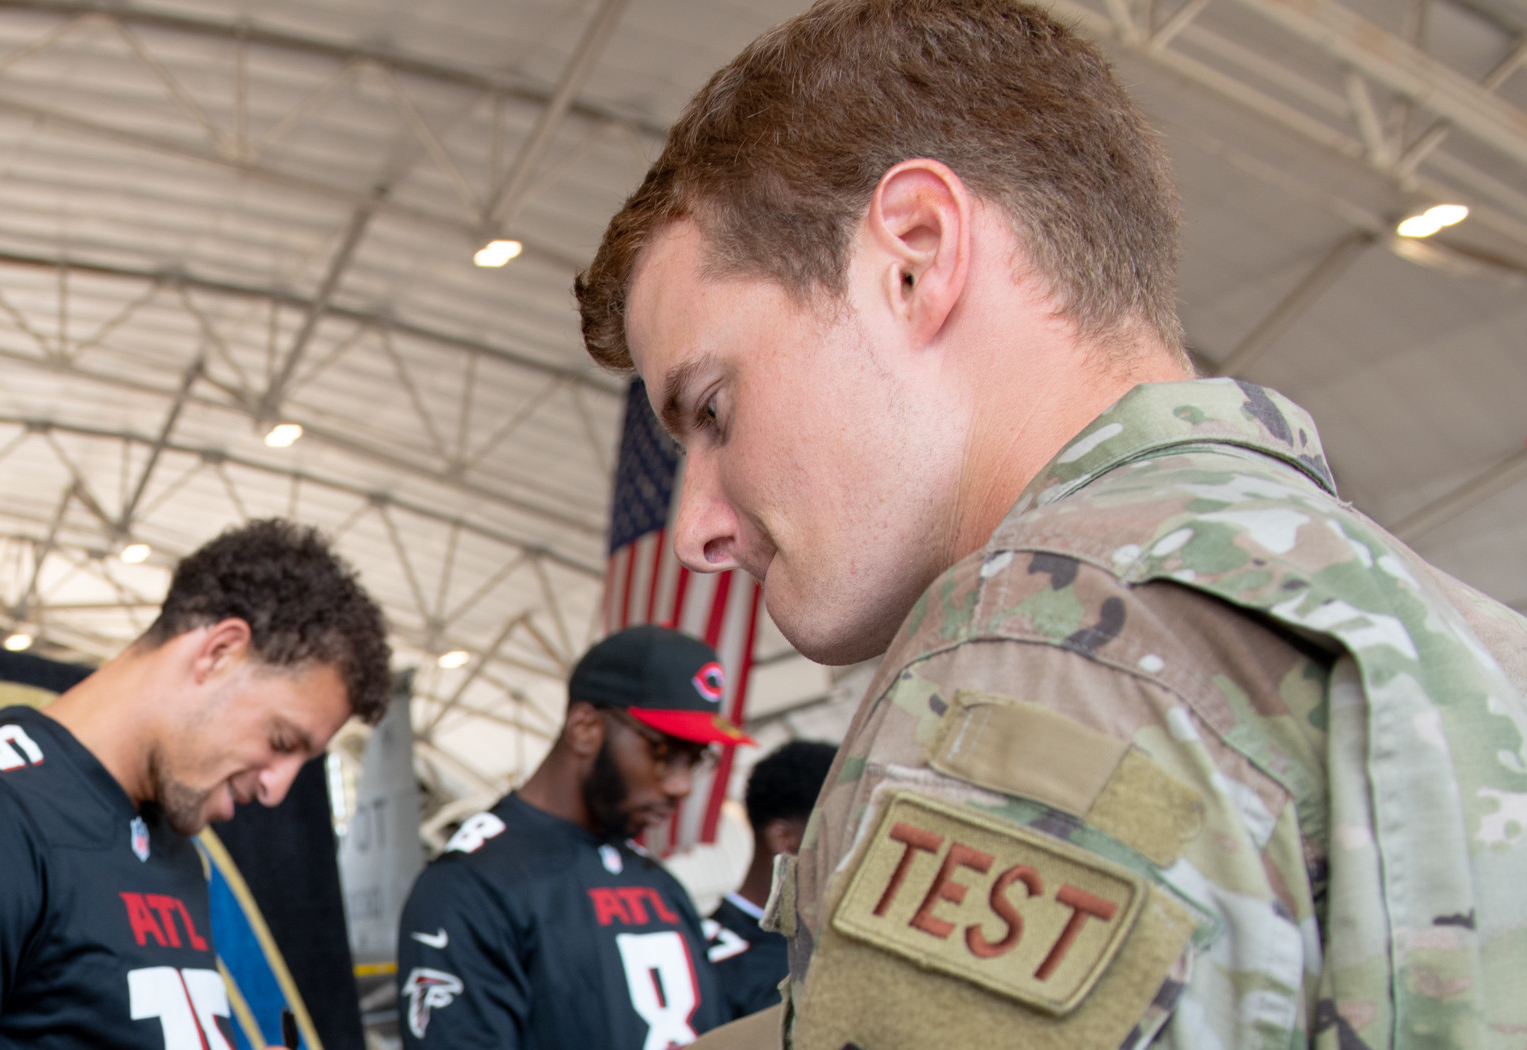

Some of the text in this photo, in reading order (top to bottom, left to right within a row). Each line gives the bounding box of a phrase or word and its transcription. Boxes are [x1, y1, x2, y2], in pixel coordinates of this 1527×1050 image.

[118, 891, 209, 952] ATL
[587, 887, 681, 926] ATL
[873, 822, 1117, 982] TEST
